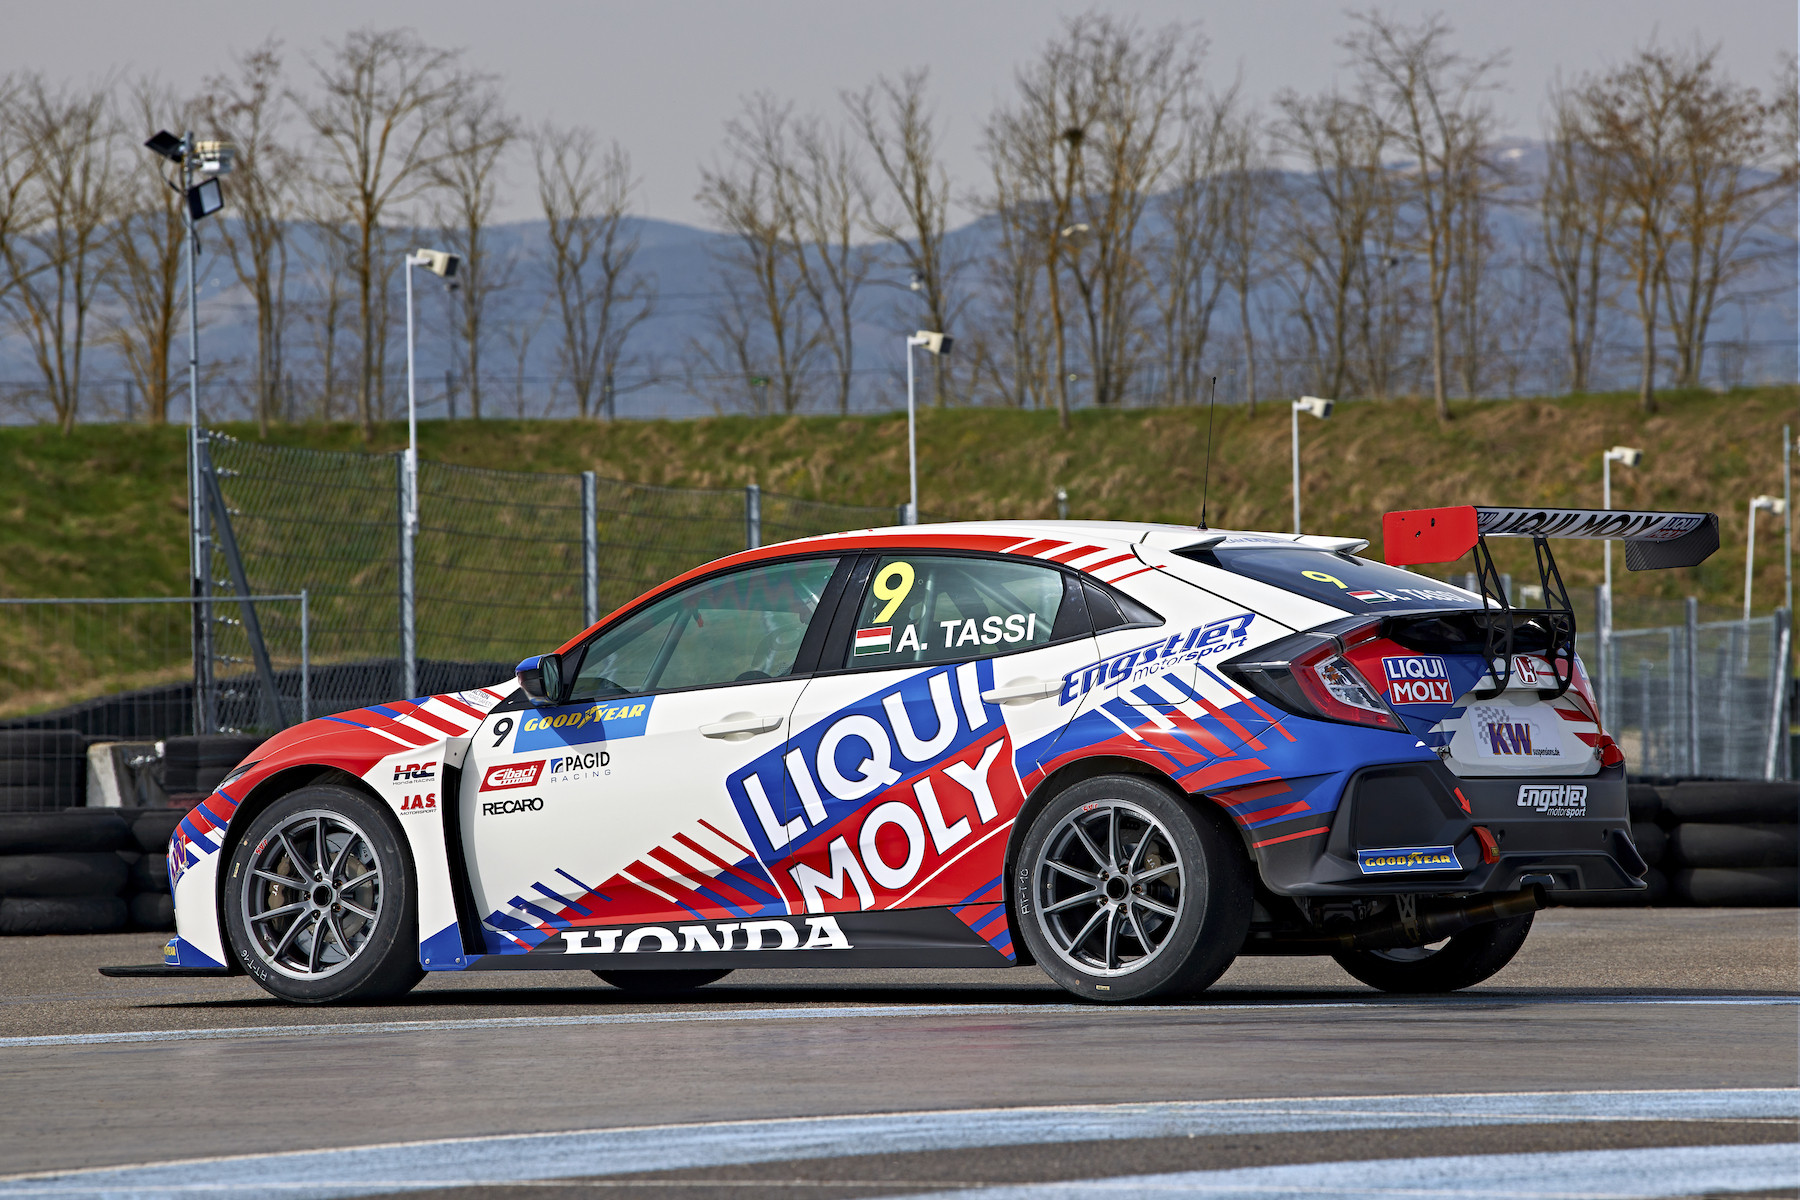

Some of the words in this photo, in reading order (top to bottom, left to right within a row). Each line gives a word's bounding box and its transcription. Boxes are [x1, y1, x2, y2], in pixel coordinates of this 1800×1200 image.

[1484, 512, 1580, 536] LIQUI
[1562, 514, 1666, 537] MOLY
[1663, 517, 1700, 530] LIQUI
[1301, 570, 1348, 589] 9
[872, 561, 915, 623] 9
[1376, 589, 1412, 602] A.
[1396, 589, 1471, 603] TASSI
[895, 623, 927, 653] A.
[940, 613, 1035, 648] TASSI
[1133, 636, 1247, 682] motorsport
[1387, 659, 1445, 678] LIQUI
[1392, 681, 1448, 702] MOLY
[524, 704, 646, 731] GOODYEAR
[492, 717, 514, 748] 9
[1487, 723, 1533, 755] KW
[566, 751, 610, 771] PAGID
[741, 661, 988, 851] LIQUI
[393, 762, 437, 780] HRC
[487, 765, 539, 786] Eibach
[551, 769, 611, 783] RACING
[482, 797, 544, 816] RECARO
[1547, 806, 1586, 819] motorsport
[788, 736, 1005, 913] MOLY
[1365, 852, 1451, 867] GOODYEAR
[560, 916, 854, 954] HONDA
